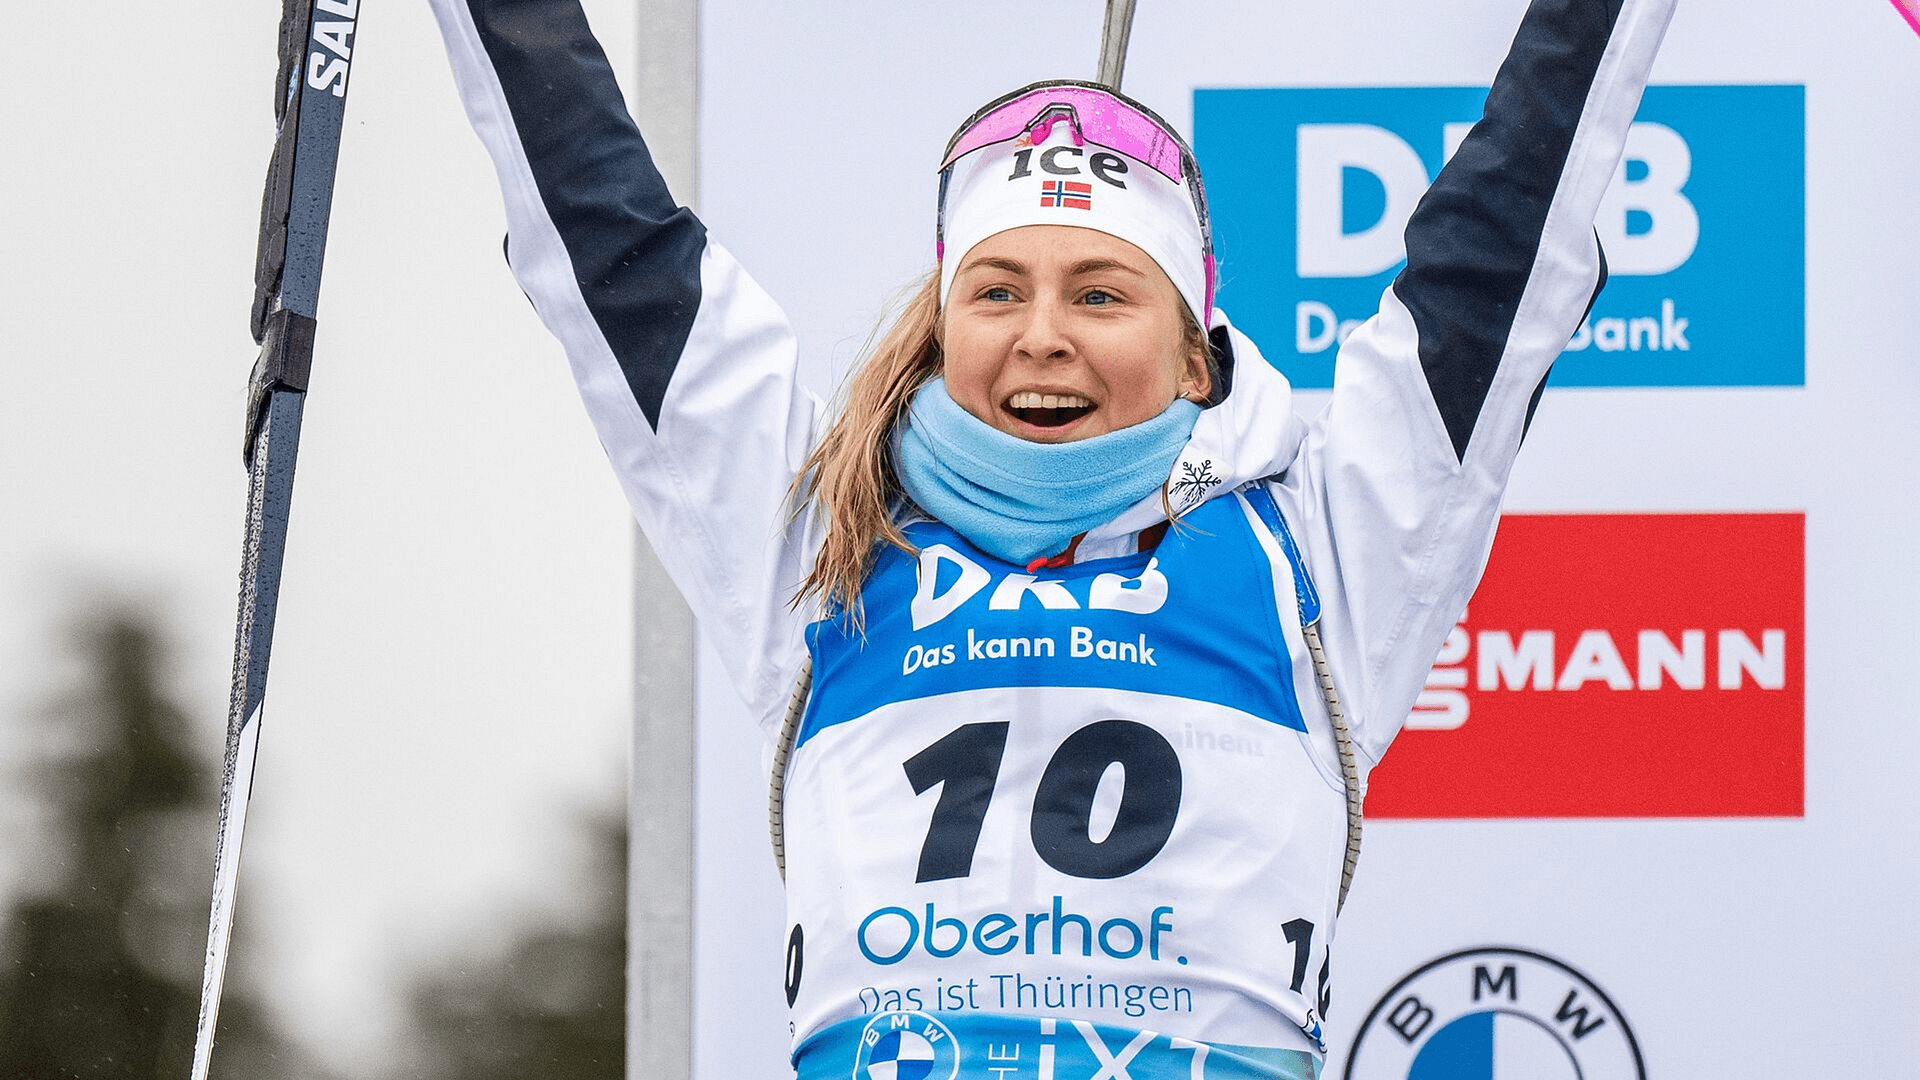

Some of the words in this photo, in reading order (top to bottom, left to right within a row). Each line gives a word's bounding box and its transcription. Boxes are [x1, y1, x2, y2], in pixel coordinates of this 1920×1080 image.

[1008, 146, 1128, 190] ice
[1296, 122, 1698, 278] DB
[910, 543, 1169, 632] DKB
[902, 644, 956, 676] Das
[967, 628, 1055, 661] kann
[1070, 626, 1158, 667] Bank
[902, 719, 1182, 884] 10
[857, 896, 1189, 966] Oberhof.
[937, 977, 981, 1011] ist
[990, 972, 1193, 1018] Thüringen
[1386, 965, 1605, 1046] BMW
[863, 1013, 946, 1048] BMW
